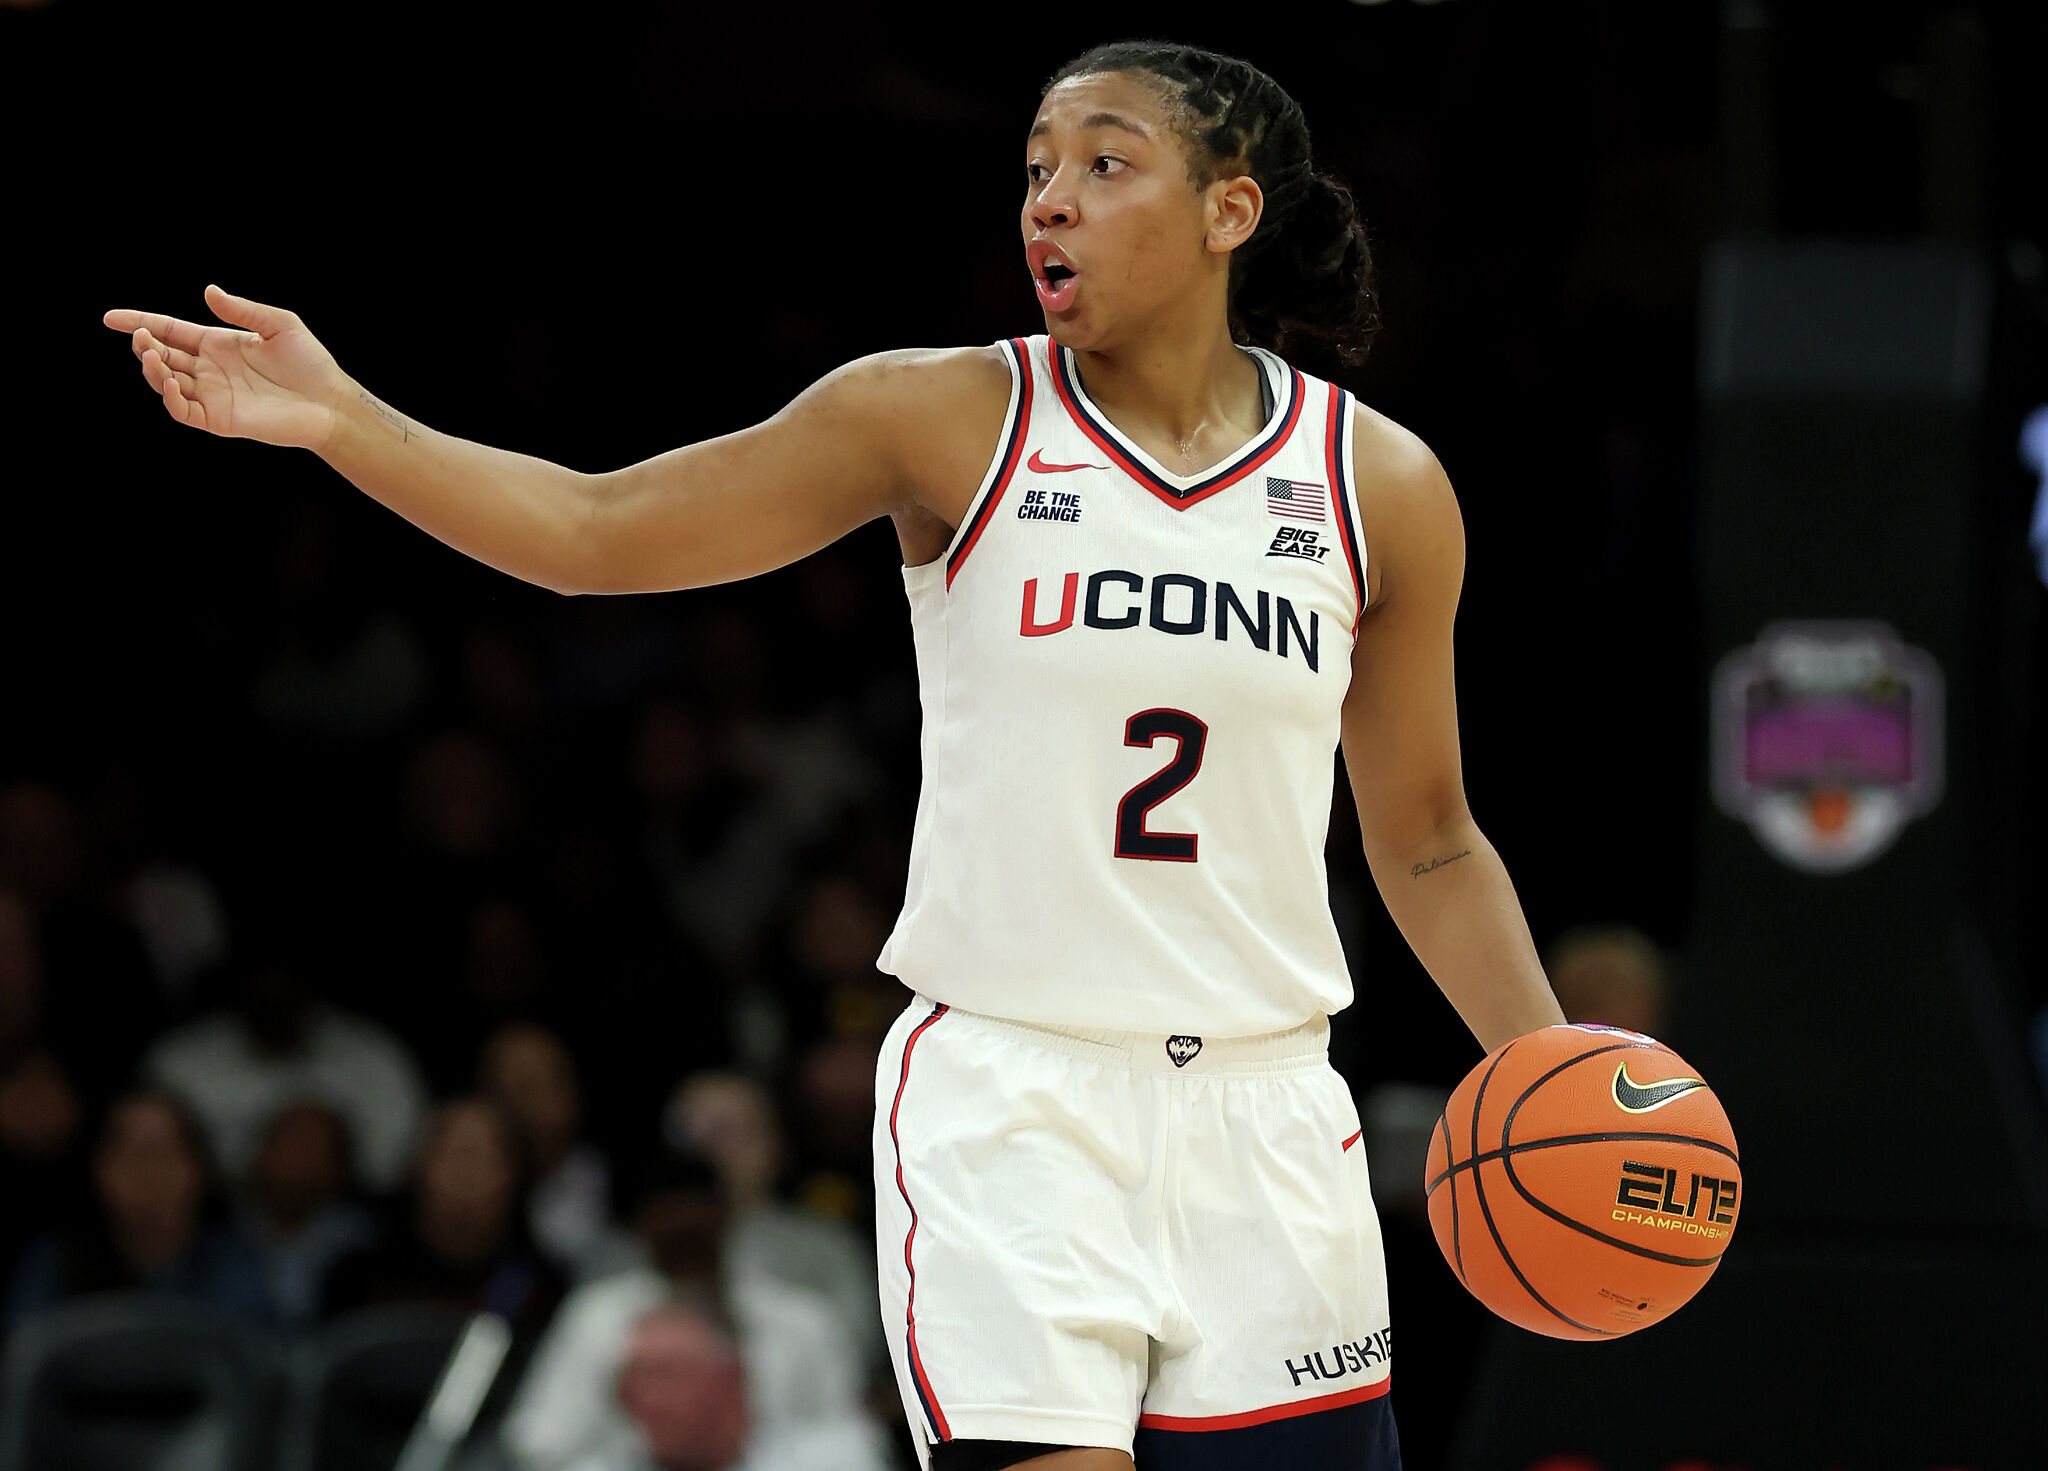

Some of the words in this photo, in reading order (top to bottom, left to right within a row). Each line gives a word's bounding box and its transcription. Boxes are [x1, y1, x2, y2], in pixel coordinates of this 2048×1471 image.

[1025, 490, 1047, 504] BE
[1051, 492, 1080, 507] THE
[1017, 504, 1082, 522] CHANGE
[1276, 526, 1319, 543] BIG
[1270, 539, 1330, 558] EAST
[1019, 570, 1318, 673] UCONN
[1114, 707, 1208, 862] 2
[1616, 1160, 1737, 1225] ELITE
